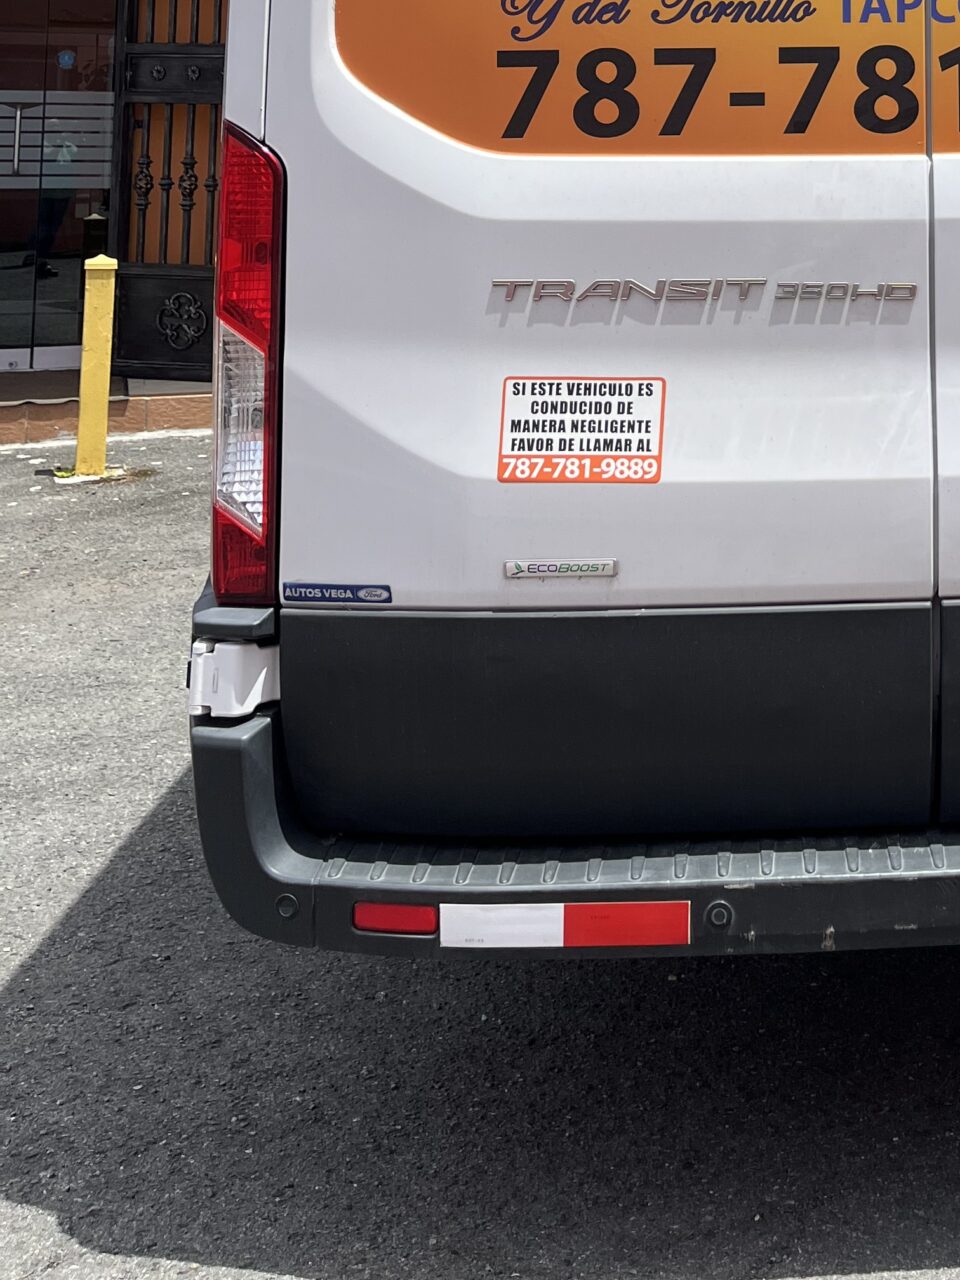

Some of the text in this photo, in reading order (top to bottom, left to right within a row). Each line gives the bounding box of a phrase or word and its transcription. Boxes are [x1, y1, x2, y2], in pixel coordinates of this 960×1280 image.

[491, 276, 919, 302] TRANSIT 350HD
[512, 381, 654, 397] SI ESTE VEHICULO ES
[530, 400, 634, 416] CONDUCIDO DE
[510, 419, 652, 434] MANERA NEGLIGENTE
[510, 437, 653, 453] FAVOR DE LLAMAR AL
[501, 457, 659, 480] 787-781-9889
[527, 563, 610, 574] ECOBOOST
[284, 587, 384, 599] AUTOS VEGA Ford
